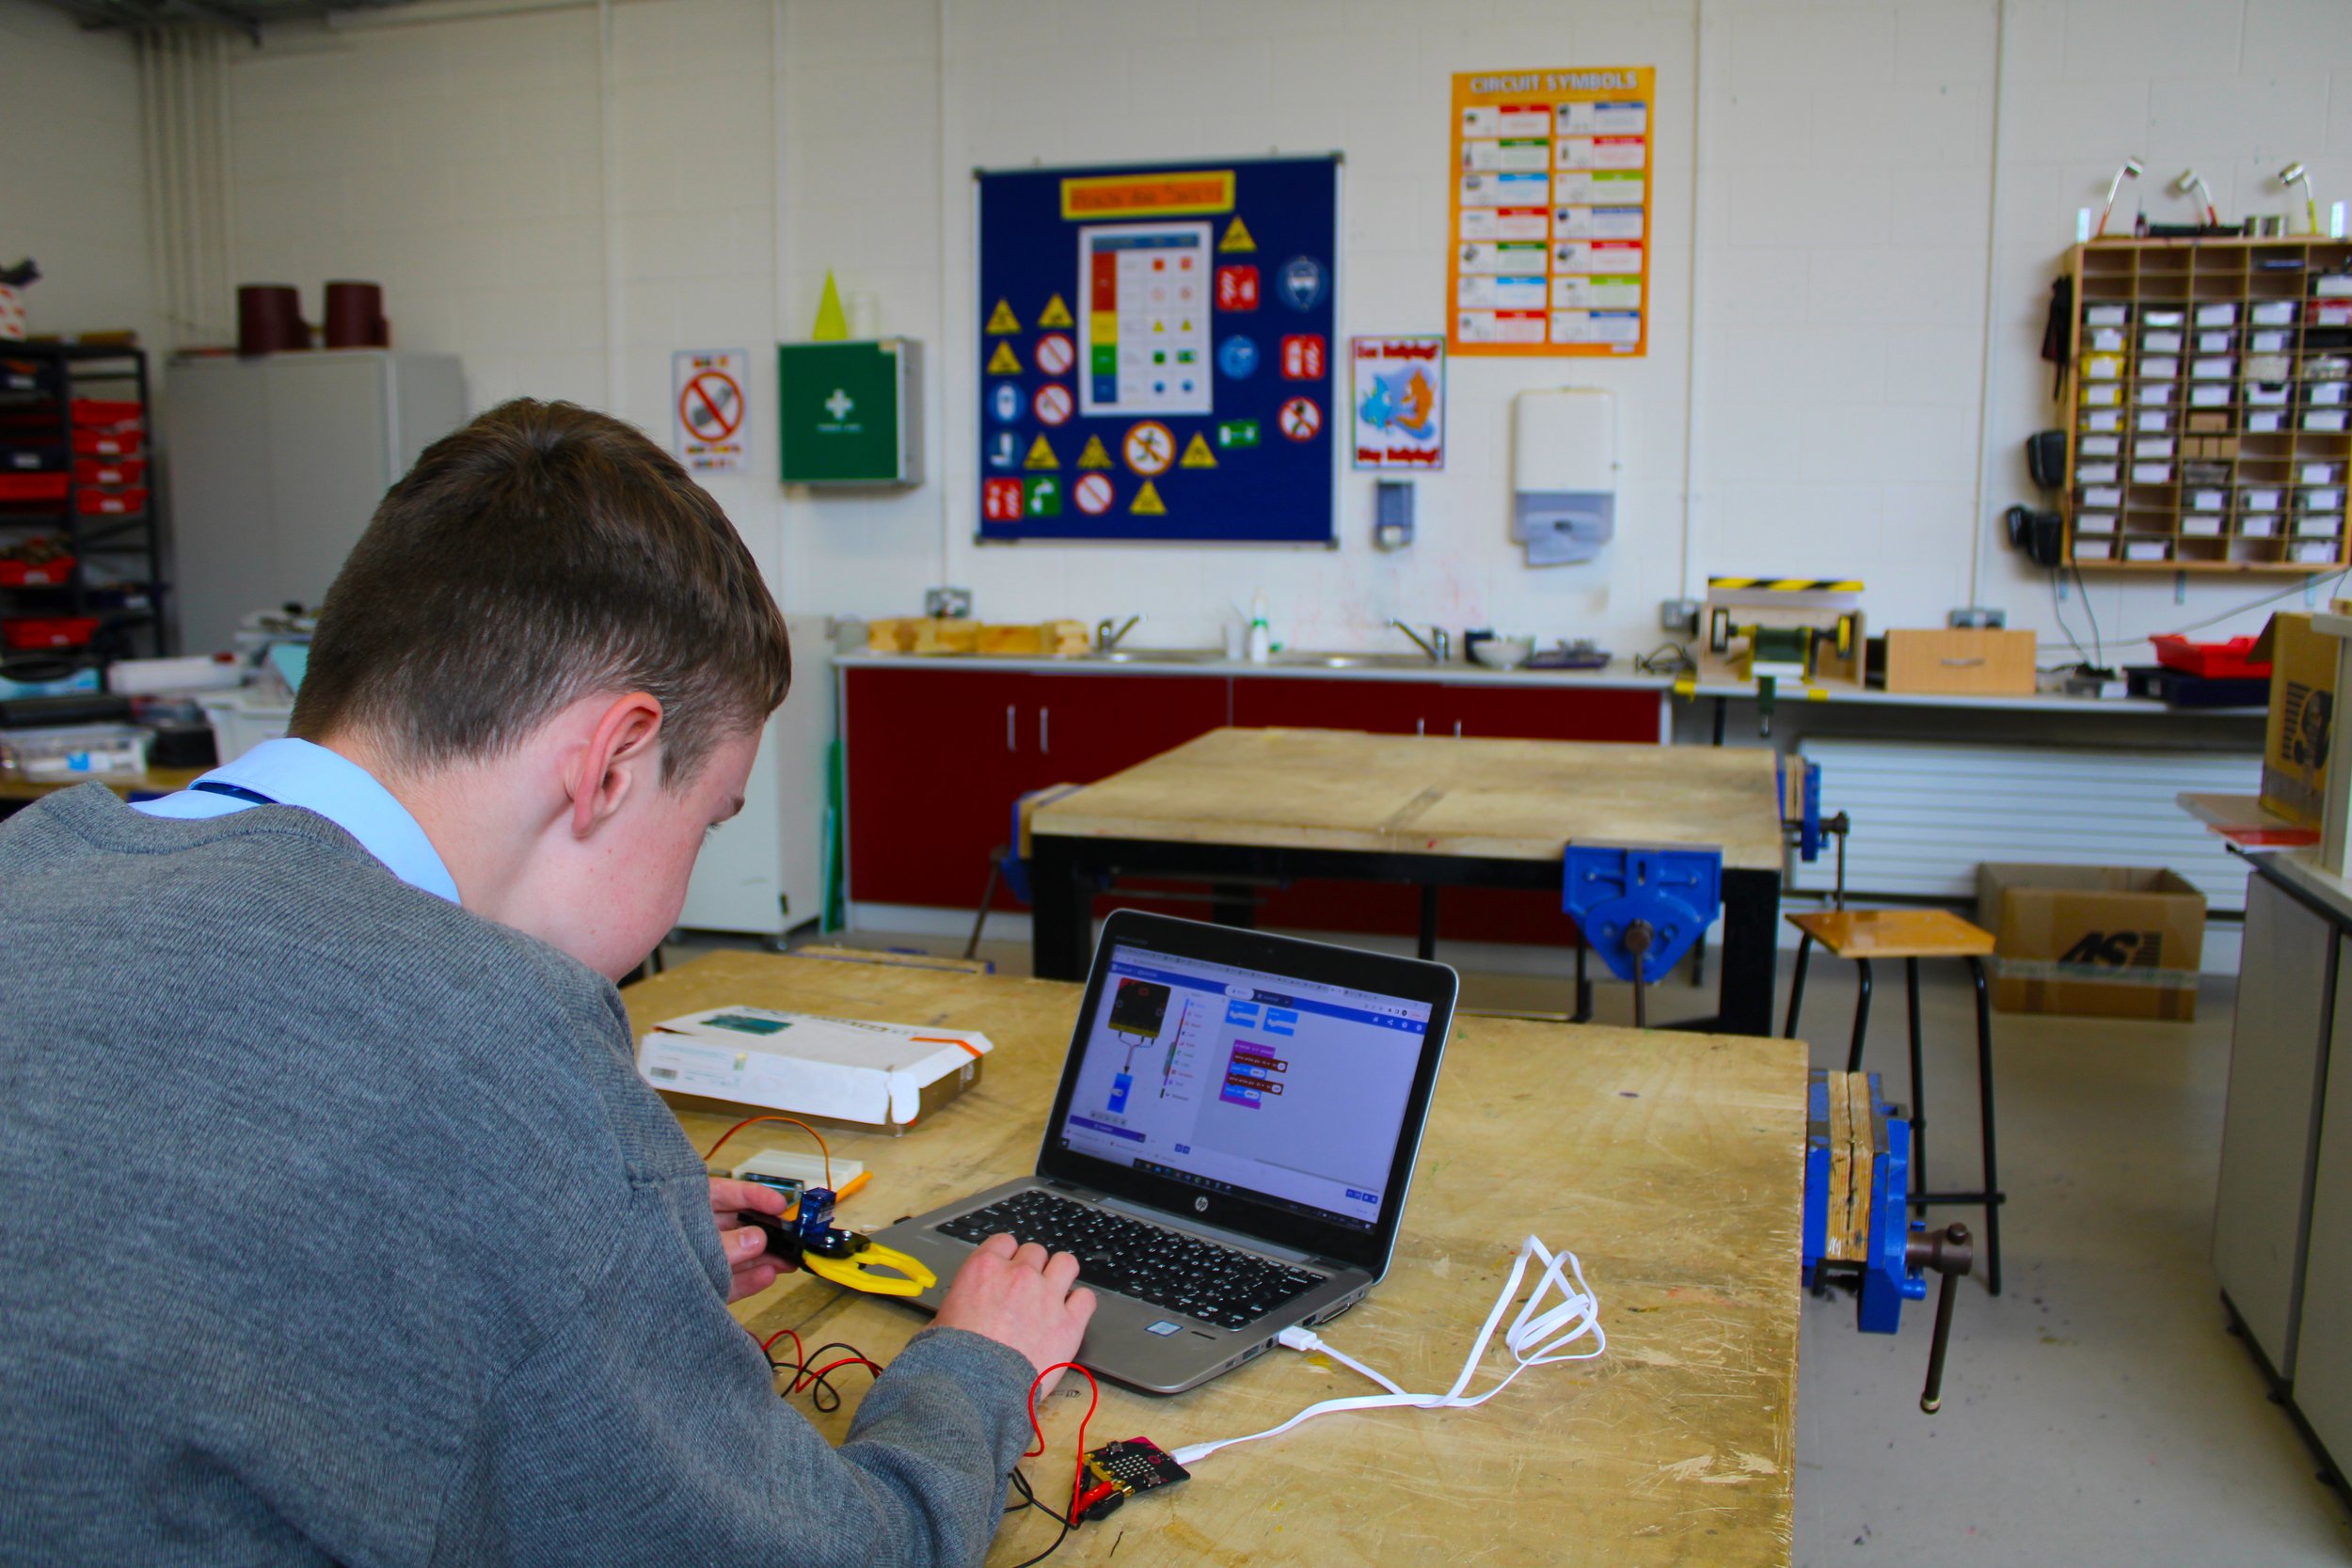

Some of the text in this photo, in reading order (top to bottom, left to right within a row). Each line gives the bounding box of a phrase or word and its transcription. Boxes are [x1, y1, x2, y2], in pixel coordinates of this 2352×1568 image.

[1470, 71, 1637, 94] CIRCUIT SYMBOLS
[1196, 1196, 1208, 1212] hp
